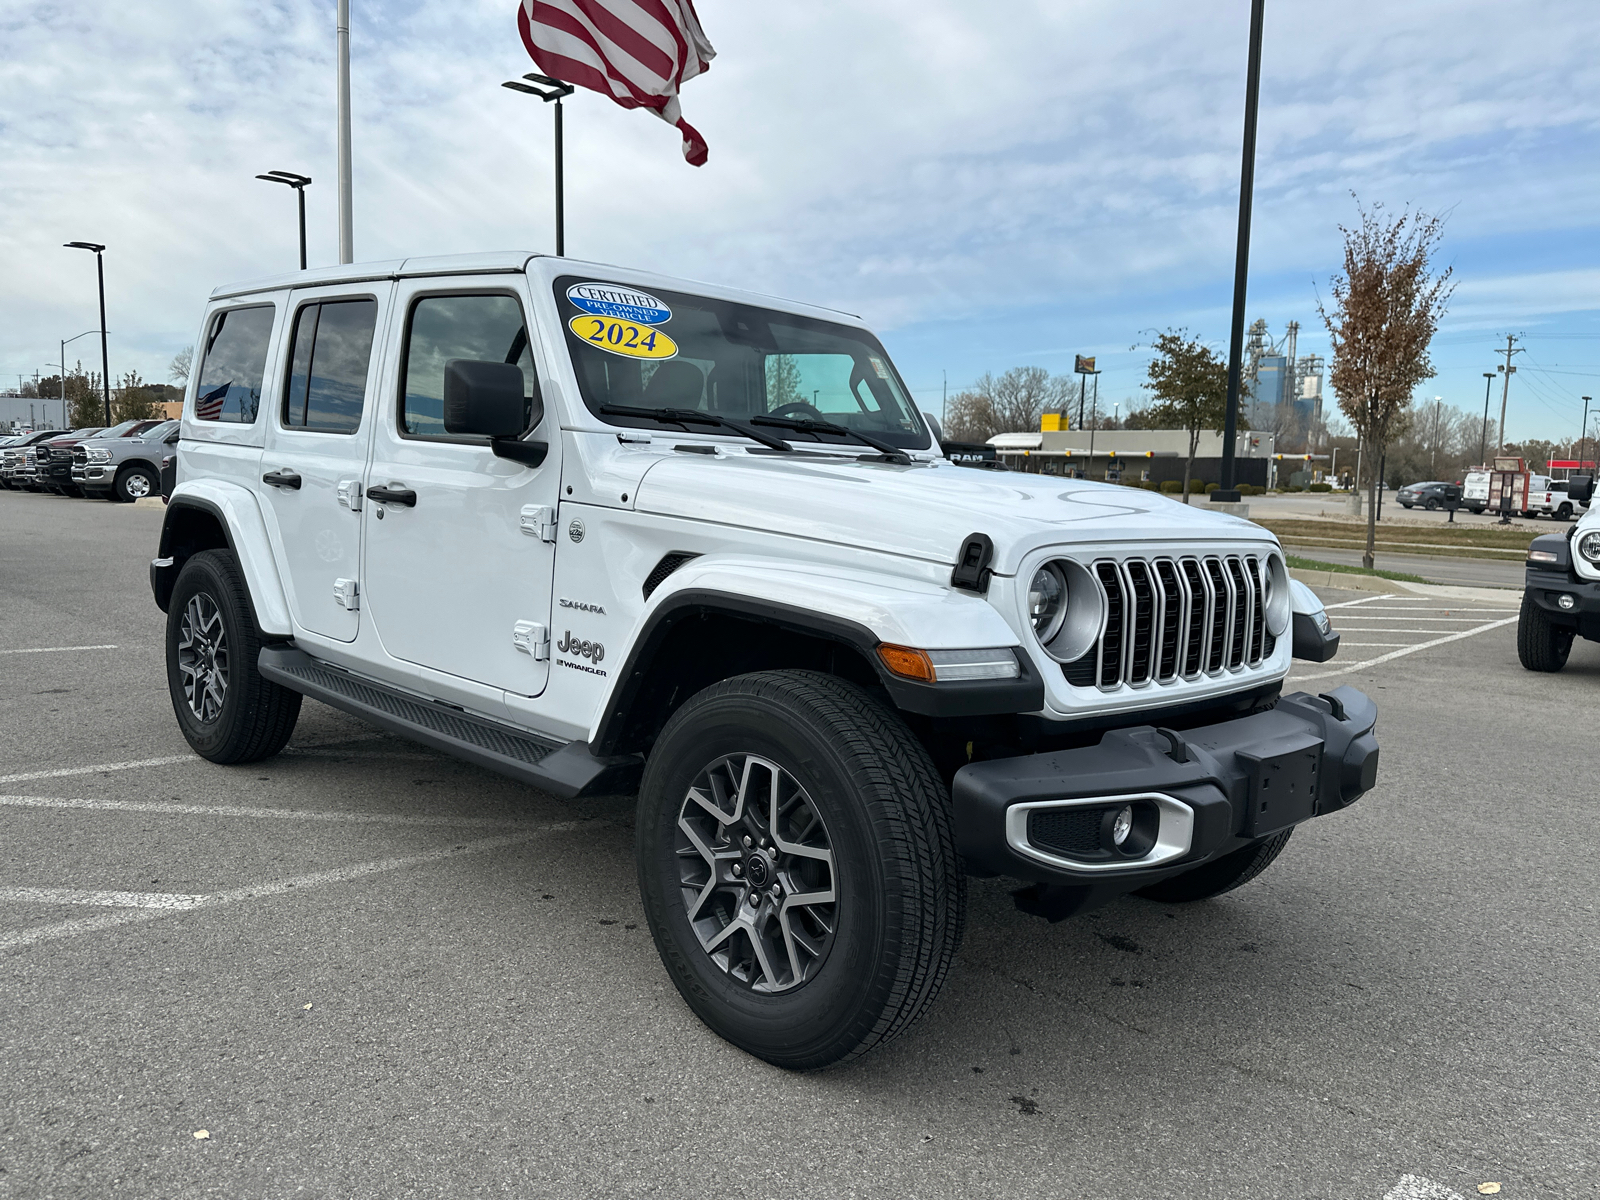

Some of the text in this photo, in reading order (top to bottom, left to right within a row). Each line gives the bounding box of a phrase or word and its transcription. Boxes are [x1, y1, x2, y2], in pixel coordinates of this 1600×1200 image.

[576, 287, 658, 309] CERTIFIED
[586, 300, 659, 317] PRE-OWNED
[588, 319, 657, 352] 2024
[950, 453, 983, 461] RAM
[559, 598, 607, 615] SAHARA
[557, 630, 605, 665] Jeep
[563, 660, 607, 677] WRANGLER
